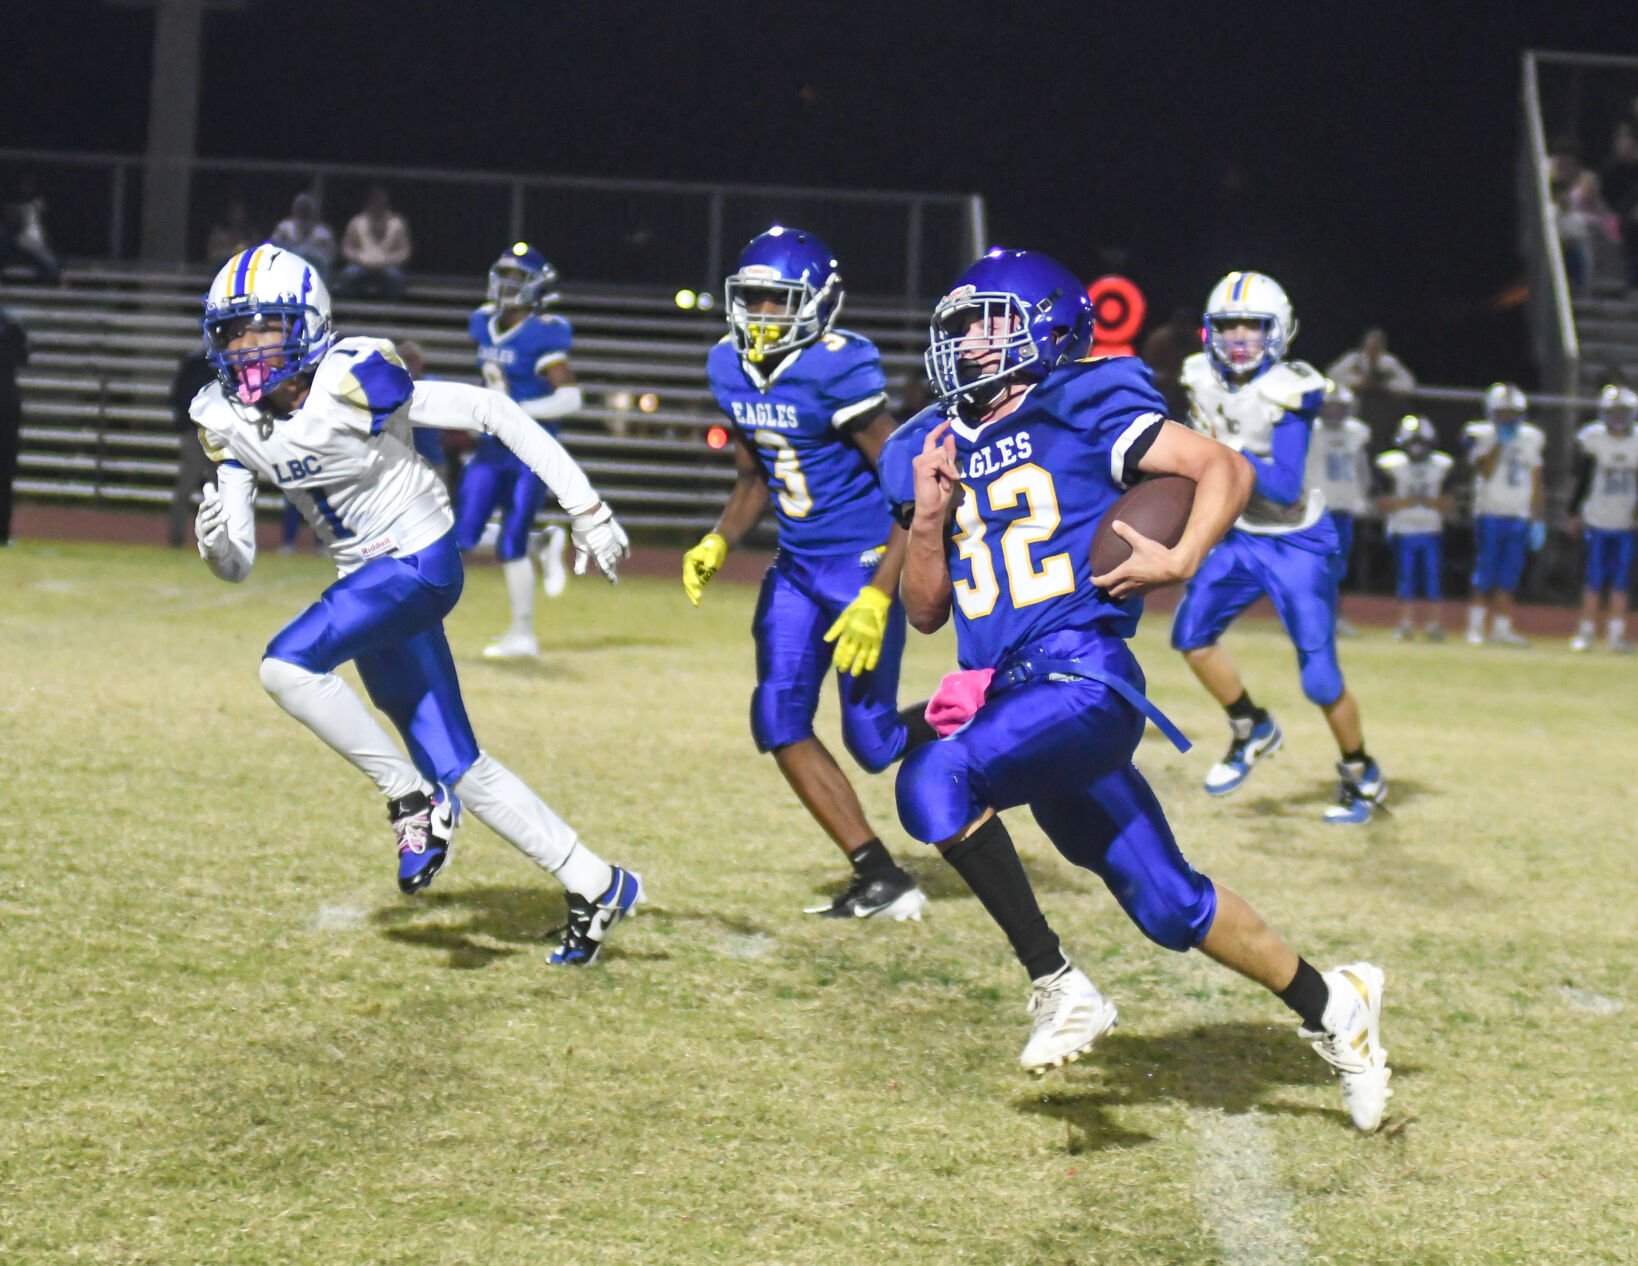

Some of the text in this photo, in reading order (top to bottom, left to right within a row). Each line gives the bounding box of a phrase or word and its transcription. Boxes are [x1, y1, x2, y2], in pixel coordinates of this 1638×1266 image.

[731, 401, 799, 429] EAGLES
[272, 455, 322, 484] LBC
[754, 429, 814, 518] 3
[960, 431, 1033, 479] GLES
[306, 486, 357, 540] 1
[951, 462, 1076, 620] 32
